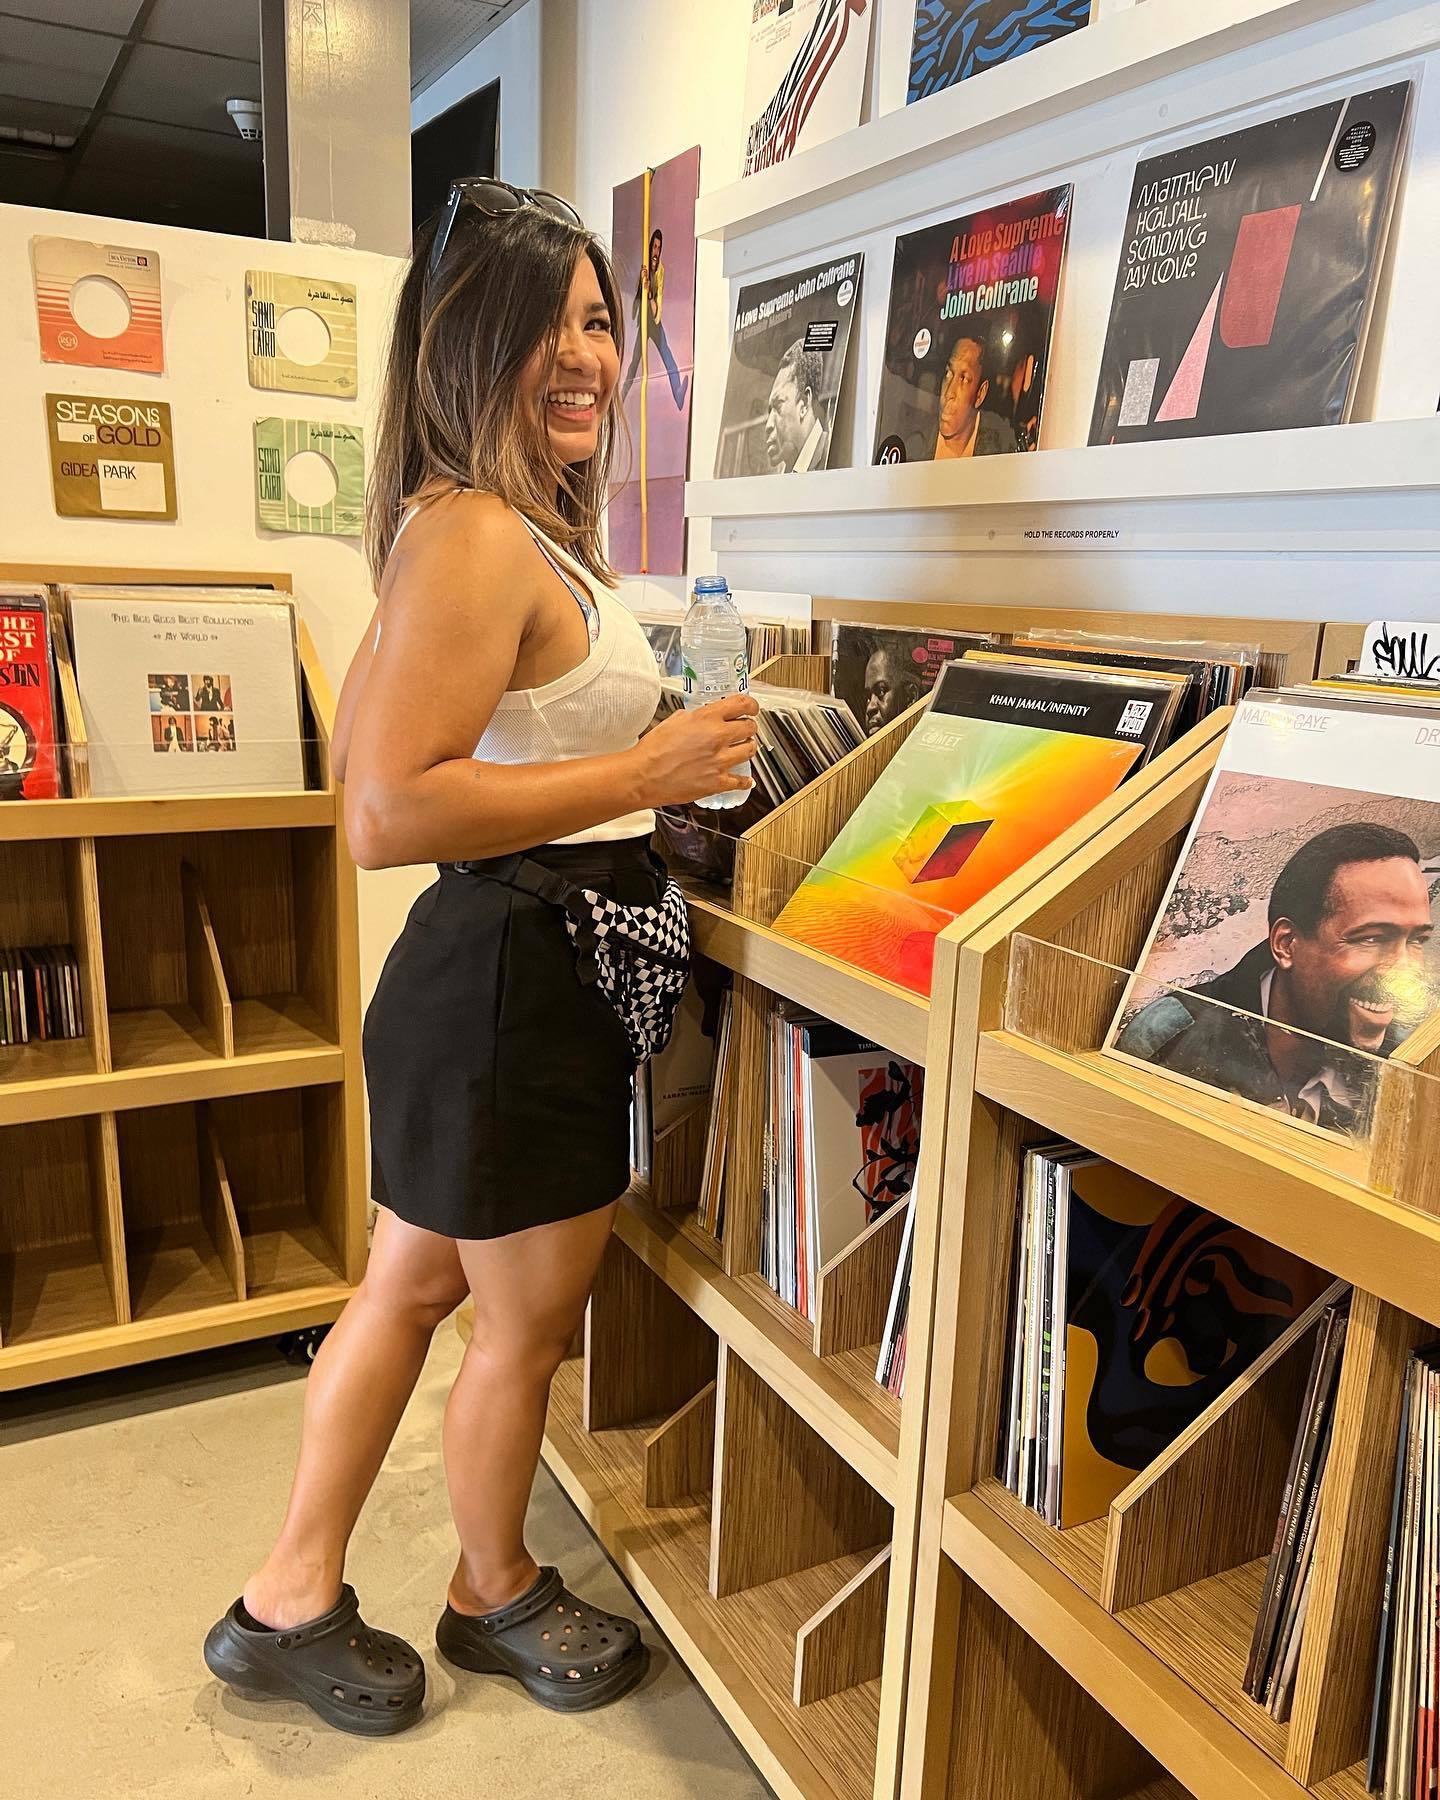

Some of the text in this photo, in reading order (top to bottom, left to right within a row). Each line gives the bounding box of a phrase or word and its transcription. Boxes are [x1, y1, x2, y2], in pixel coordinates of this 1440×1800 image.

[949, 212, 1064, 264] A Love Supreme
[1127, 223, 1208, 264] SENDING
[947, 263, 974, 291] Live
[990, 243, 1044, 280] Seattle
[1123, 264, 1150, 292] MY
[734, 314, 741, 332] A
[741, 308, 758, 328] Love
[758, 289, 794, 320] Supreme
[794, 277, 816, 302] John
[816, 259, 855, 291] Coltrane
[940, 276, 1038, 320] John Coltrane
[252, 300, 275, 330] SONO
[252, 330, 276, 358] CAIRO
[56, 400, 160, 427] SEASONS
[82, 425, 161, 447] OF GOLD
[60, 462, 136, 480] GIDEA PARK
[258, 448, 280, 474] SONO
[260, 474, 282, 500] CAIRO
[1024, 530, 1120, 538] HOLD THE RECORDS PROPERLY
[0, 616, 36, 630] HE
[111, 612, 130, 623] THE
[180, 632, 208, 642] WORLD
[989, 694, 1090, 718] KHAN JAMAL/INFINITY
[1293, 714, 1332, 730] GAYE
[1286, 1462, 1310, 1546] ERIC CLAPTON UNPLUGGED
